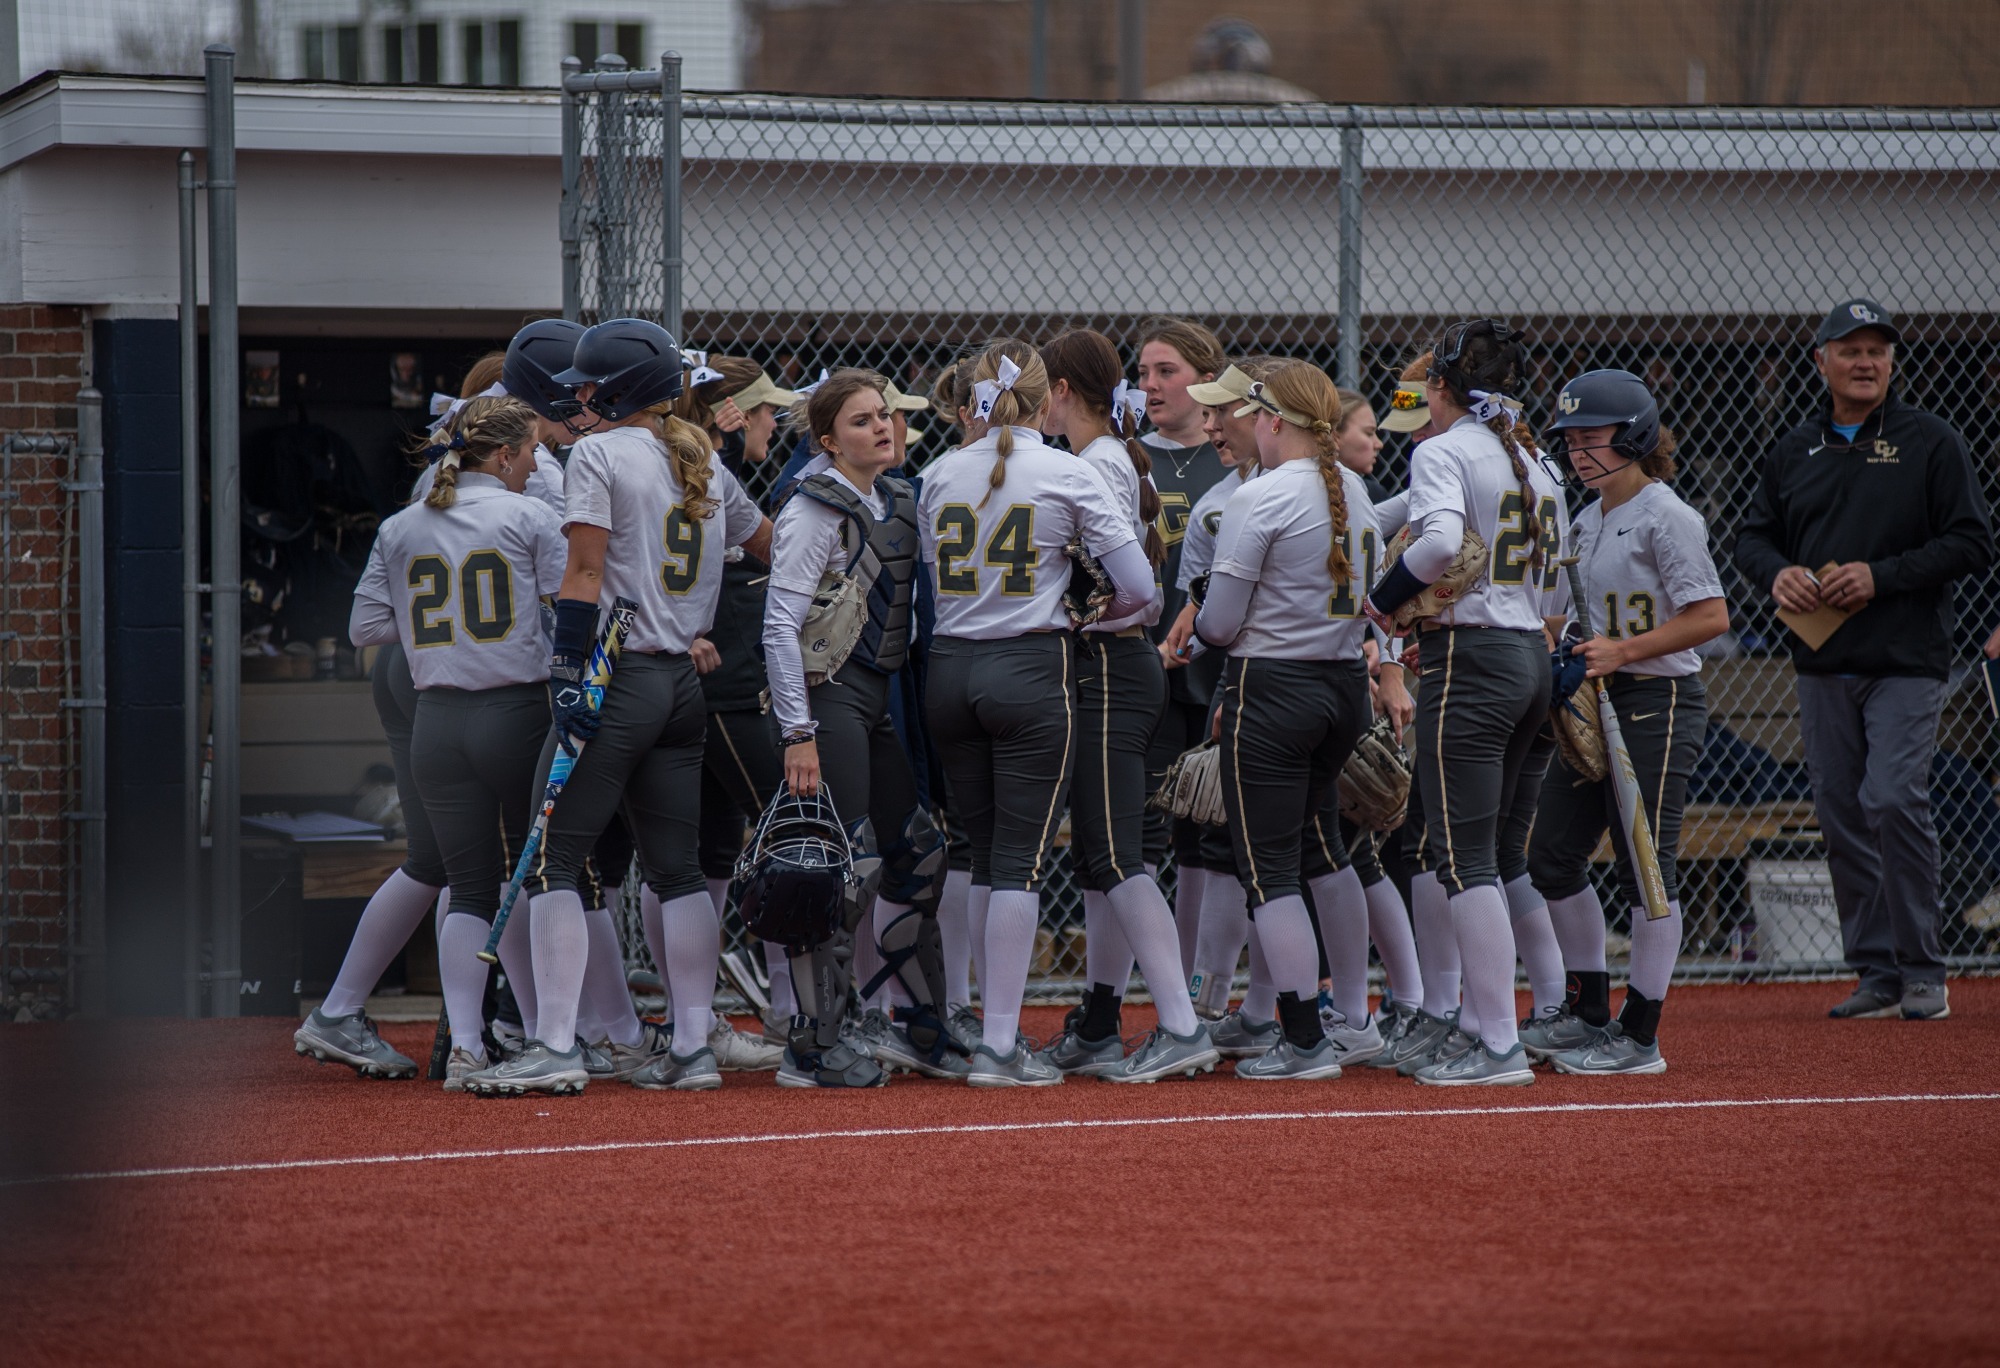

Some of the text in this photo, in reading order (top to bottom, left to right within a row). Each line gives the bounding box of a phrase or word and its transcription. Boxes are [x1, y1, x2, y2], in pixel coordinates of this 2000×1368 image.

[696, 372, 706, 381] 4
[1559, 391, 1581, 416] CU
[660, 504, 702, 596] 9
[936, 502, 1040, 597] 24
[1327, 527, 1375, 619] 11
[407, 548, 516, 650] 20
[1604, 591, 1656, 641] 13
